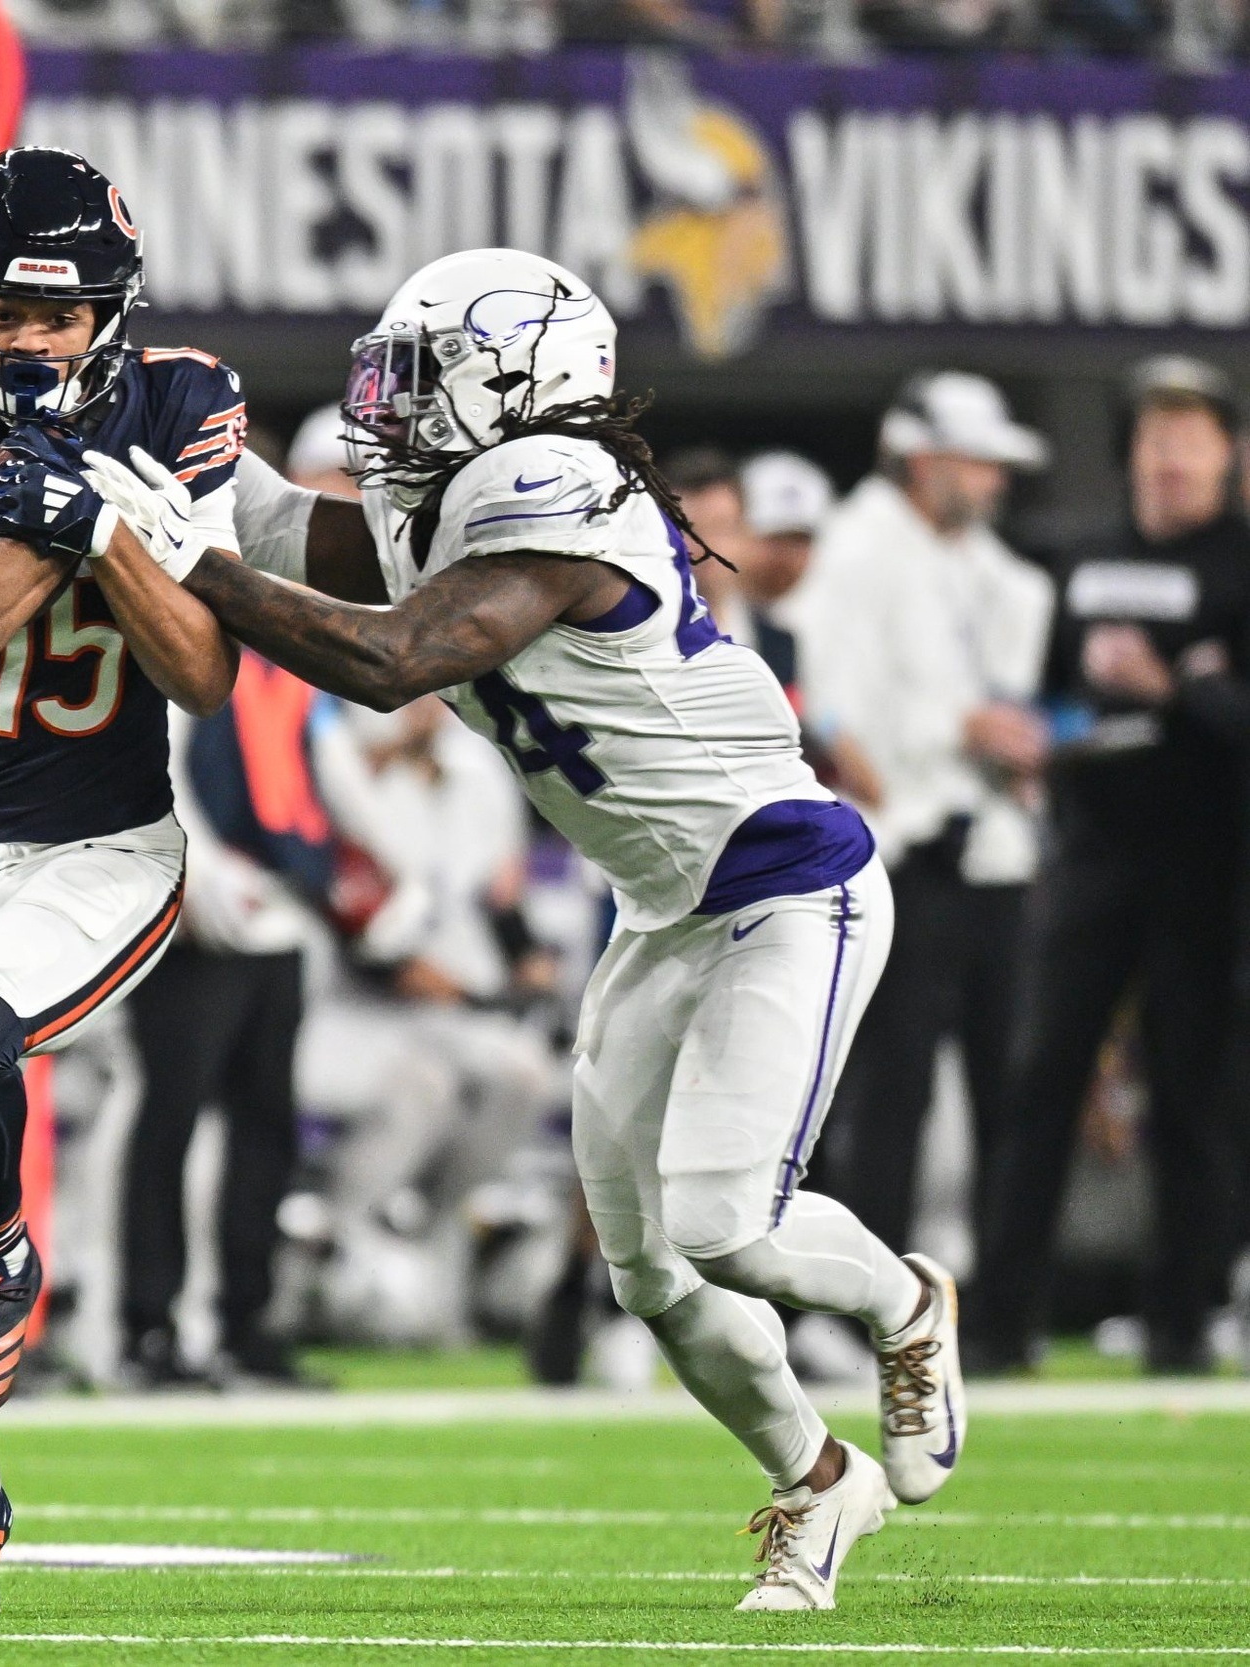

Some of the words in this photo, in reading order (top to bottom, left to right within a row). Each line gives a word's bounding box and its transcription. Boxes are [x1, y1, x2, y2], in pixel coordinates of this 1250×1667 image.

[18, 262, 69, 275] BEARS
[786, 112, 1250, 325] VIKINGS
[439, 669, 615, 801] 4
